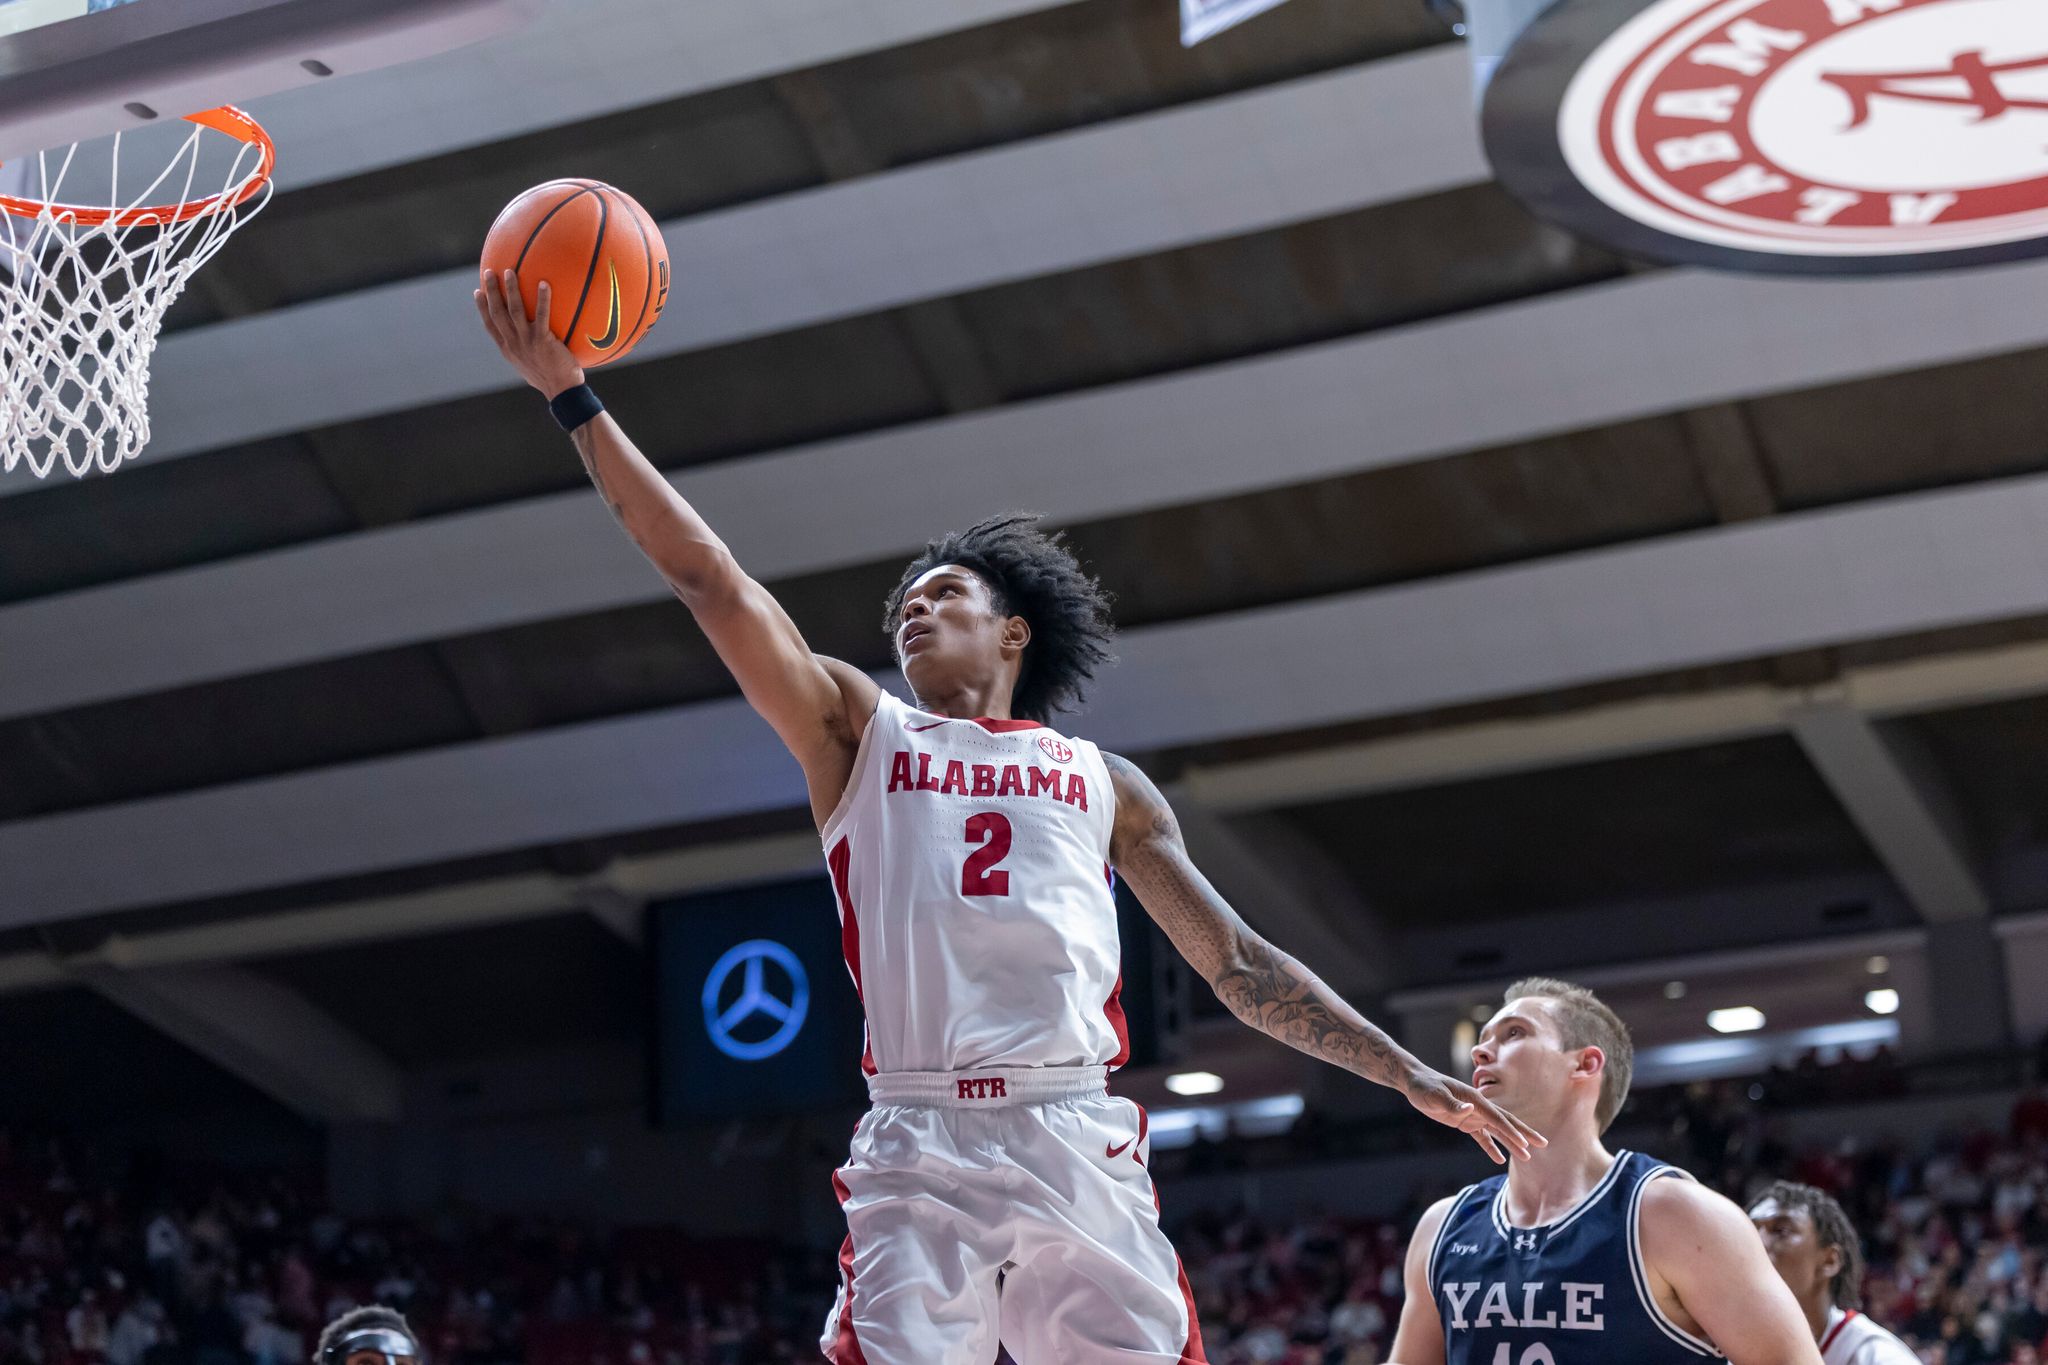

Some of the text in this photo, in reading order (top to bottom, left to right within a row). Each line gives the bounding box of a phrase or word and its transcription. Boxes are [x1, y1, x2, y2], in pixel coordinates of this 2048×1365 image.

[1039, 736, 1073, 763] SEC
[887, 751, 1088, 813] ALABAMA
[961, 811, 1012, 896] 2
[957, 1077, 1007, 1099] RTR
[1442, 1281, 1604, 1331] YALE
